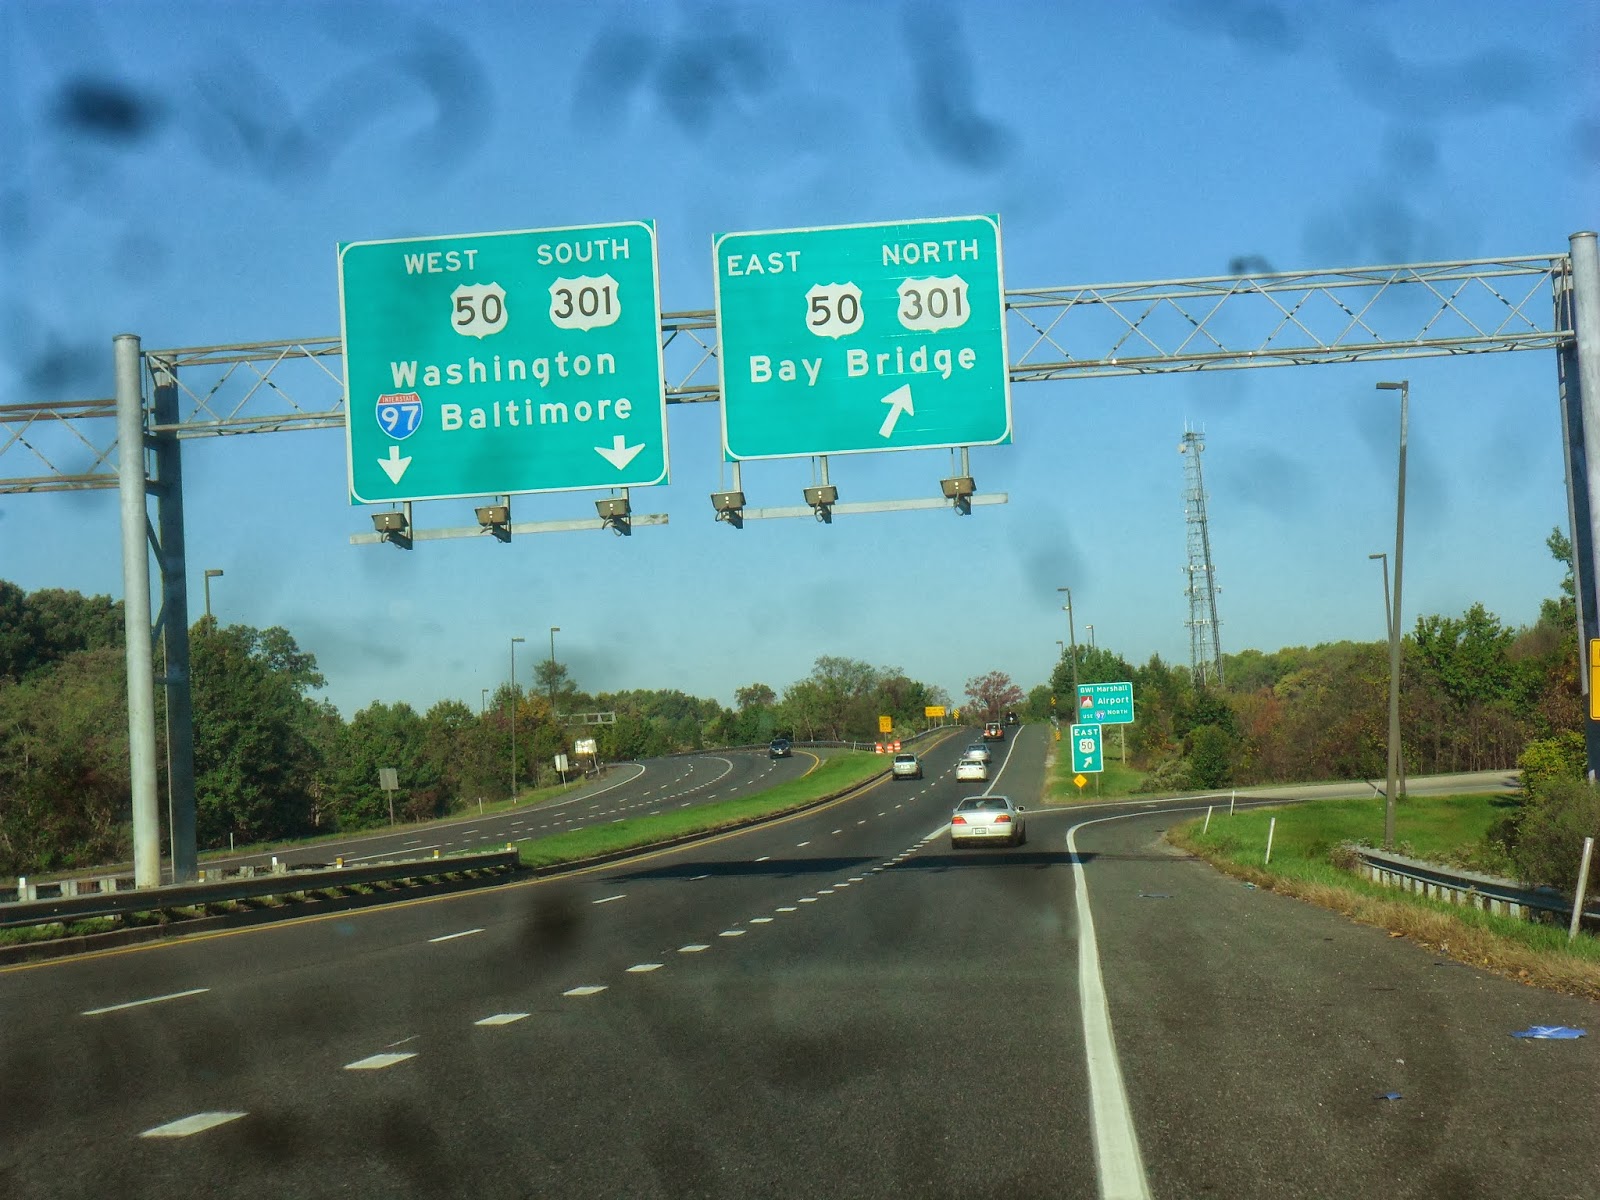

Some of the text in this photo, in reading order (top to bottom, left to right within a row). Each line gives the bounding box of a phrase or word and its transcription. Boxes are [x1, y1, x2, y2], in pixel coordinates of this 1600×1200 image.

[404, 249, 478, 275] WEST
[537, 238, 630, 266] SOUTH
[727, 251, 801, 277] EAST
[882, 238, 979, 266] NORTH
[456, 294, 502, 326] 50
[554, 285, 612, 319] 301
[811, 293, 859, 326] 50
[902, 286, 962, 321] 301
[390, 350, 616, 388] Washington
[750, 344, 977, 387] Bay Bridge
[382, 394, 416, 403] INTERSTATE
[381, 405, 419, 432] 97
[440, 397, 632, 431] Baltimore
[1096, 685, 1128, 693] Marshall
[1097, 696, 1129, 705] Airport
[1074, 728, 1099, 736] EAST
[1081, 741, 1093, 750] 50
